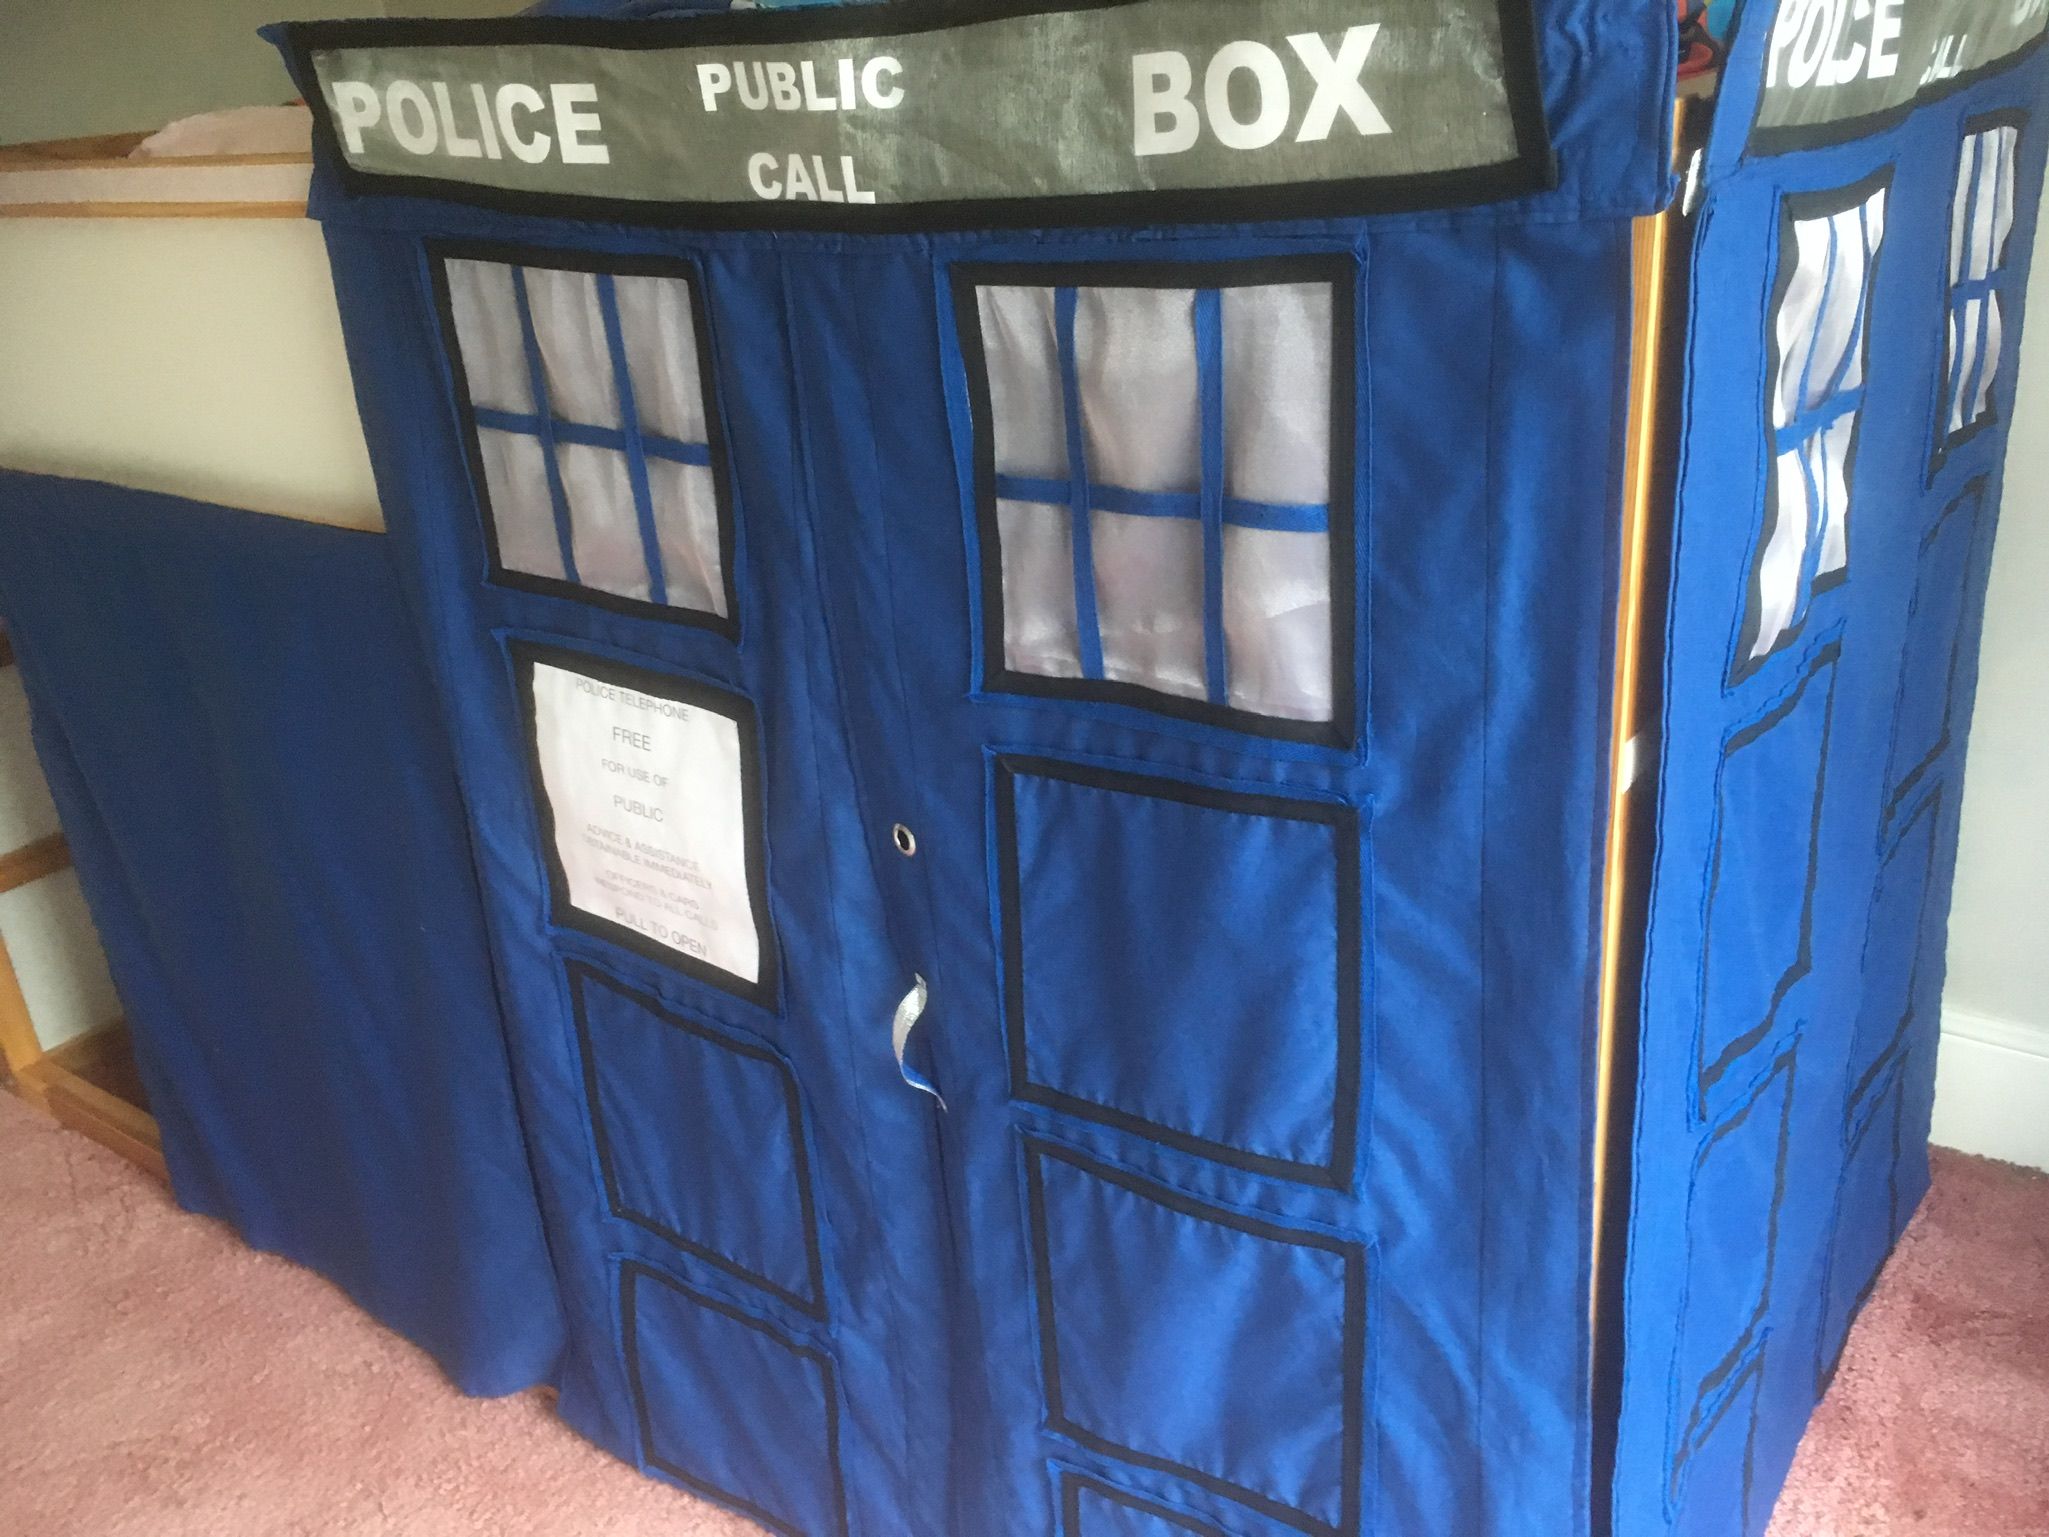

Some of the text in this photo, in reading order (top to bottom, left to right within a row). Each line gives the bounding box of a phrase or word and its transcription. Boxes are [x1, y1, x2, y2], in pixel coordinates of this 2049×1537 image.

[1765, 0, 1905, 88] POLCE
[695, 55, 905, 112] PUBLIC
[1131, 23, 1393, 157] BOX
[331, 80, 611, 165] POLICE
[747, 152, 876, 205] CALL
[575, 677, 690, 722] POLICE TELEPHONE
[612, 726, 652, 752] FREE
[601, 758, 669, 788] FOR USE OF
[613, 794, 664, 823] PUBLIC
[615, 905, 708, 957] PULL TO OPEN
